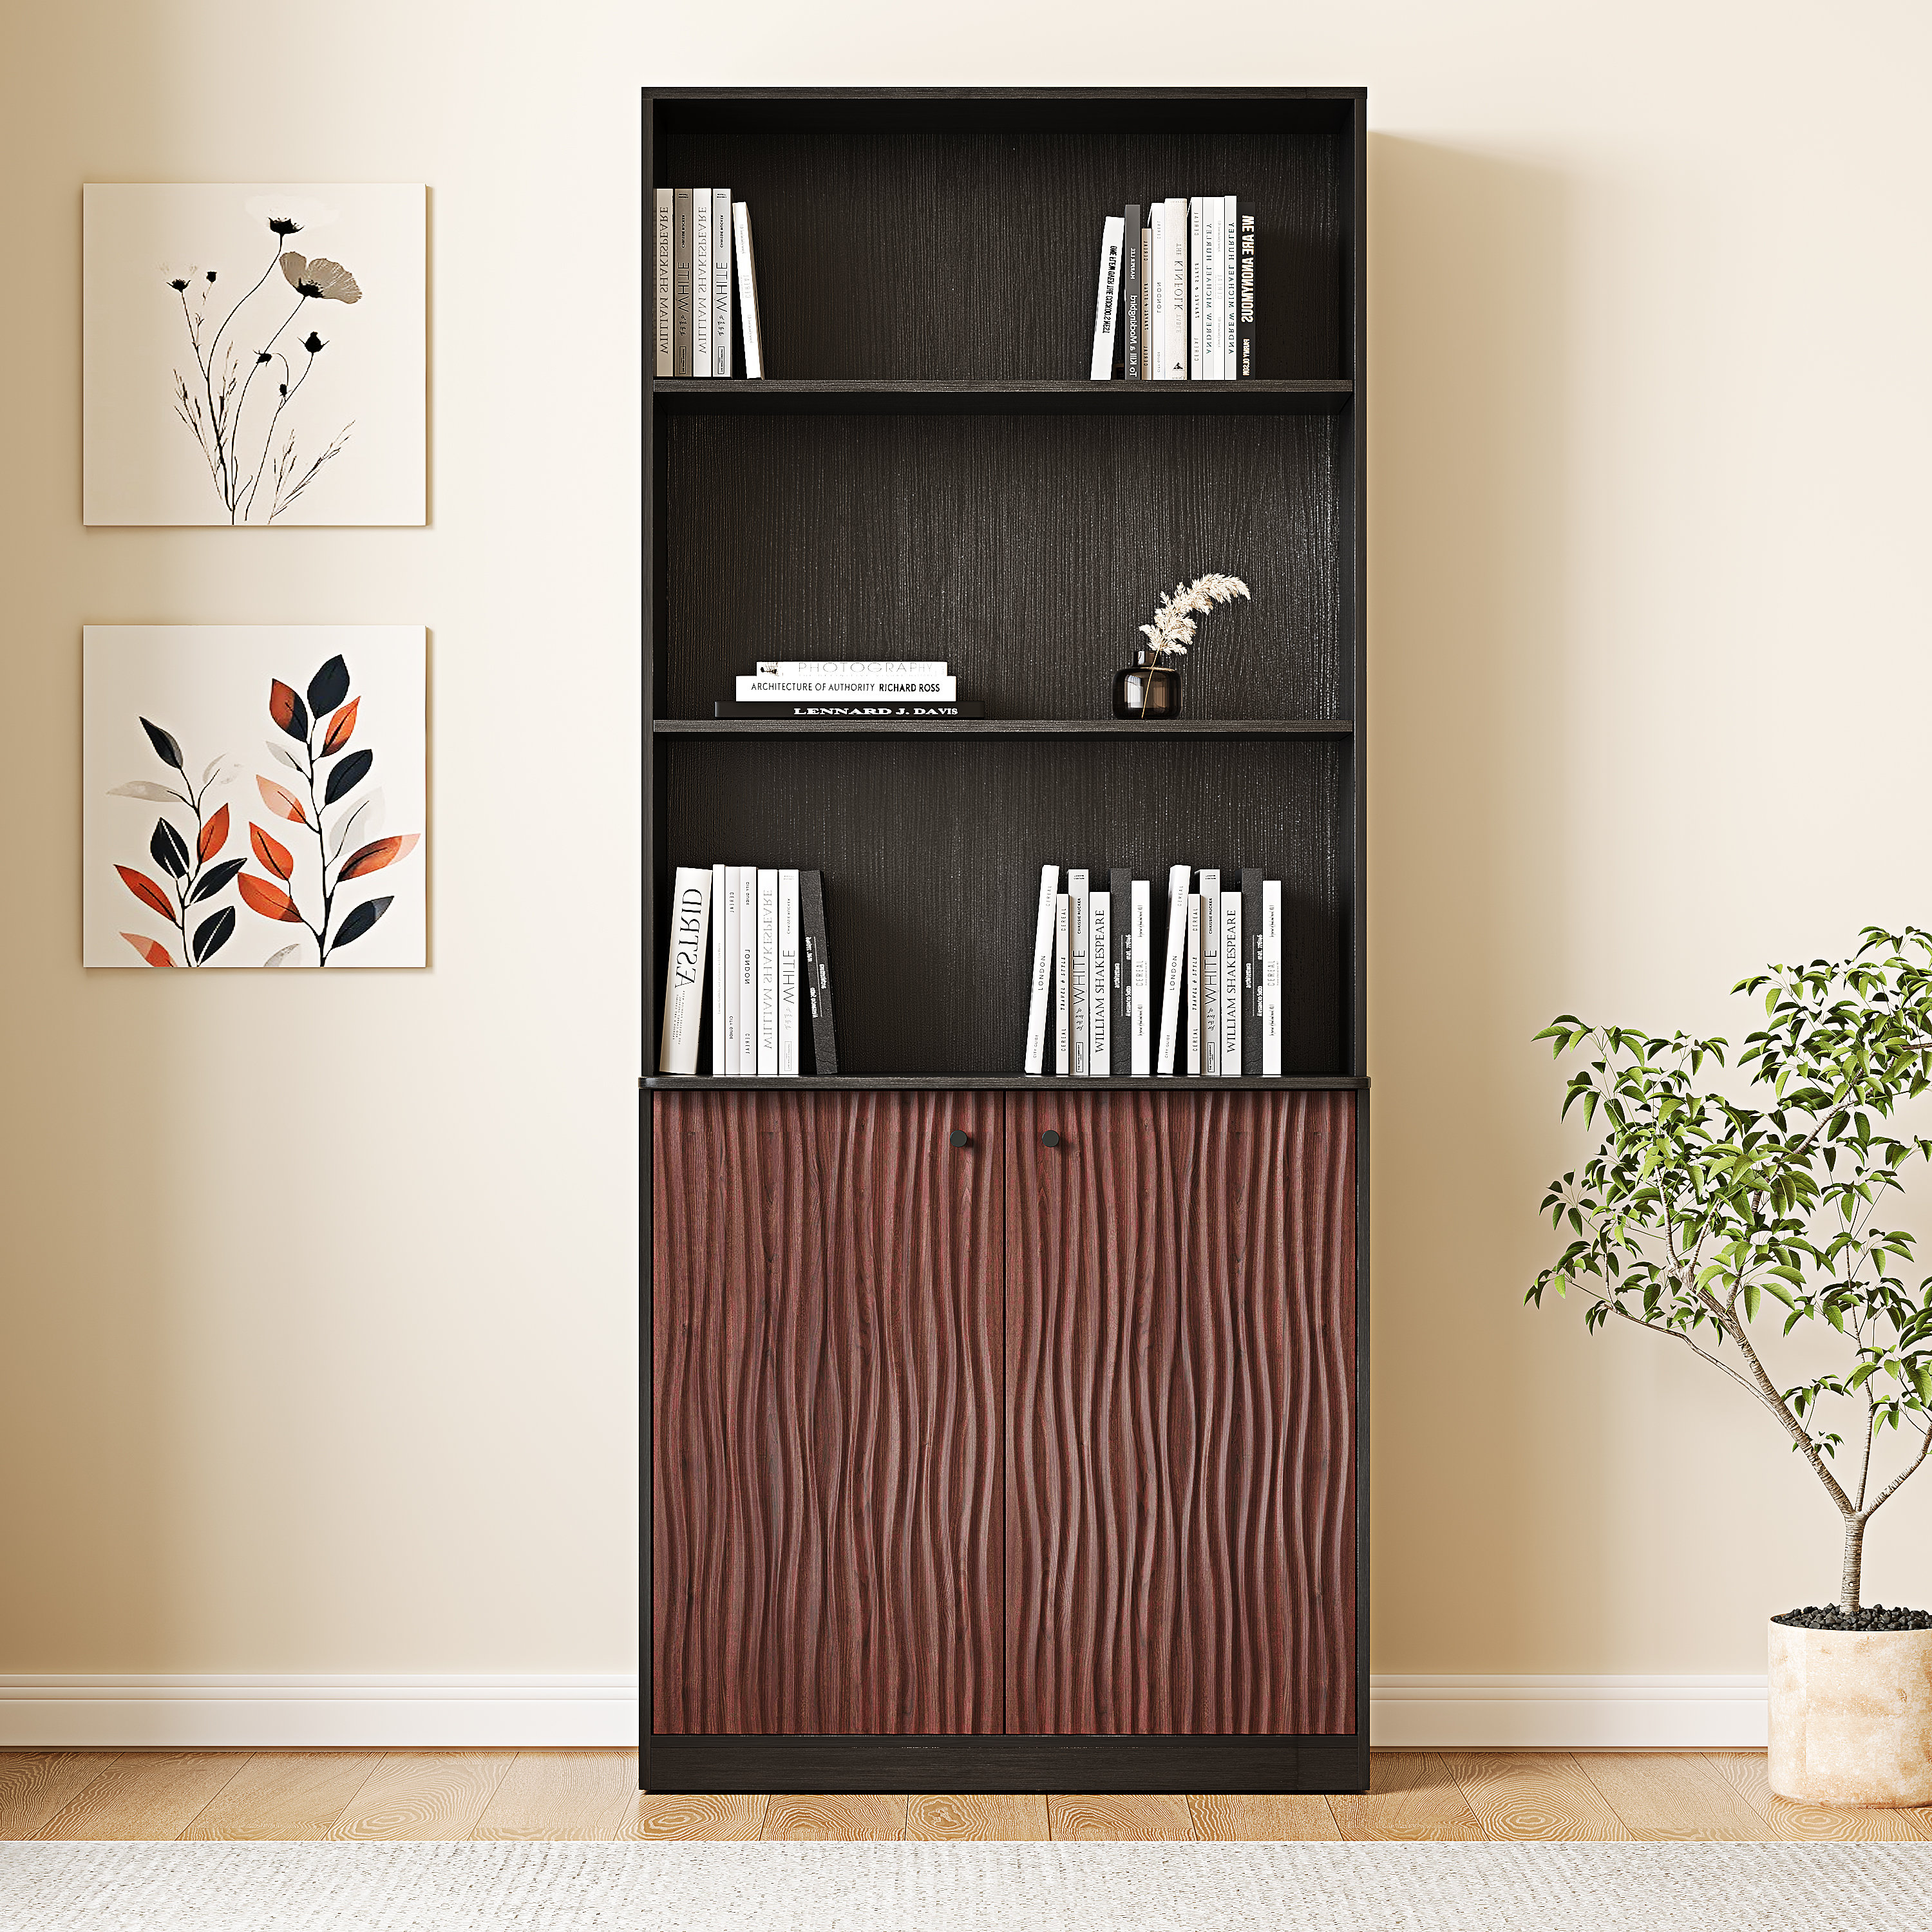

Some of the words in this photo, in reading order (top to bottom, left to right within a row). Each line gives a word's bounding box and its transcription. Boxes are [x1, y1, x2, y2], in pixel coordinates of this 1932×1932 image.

[798, 662, 933, 672] PHOTOGRAPHY
[751, 682, 813, 691] ARCHITECTURE
[815, 683, 826, 691] OF
[828, 683, 875, 692] AUTHORITY
[879, 683, 916, 692] RICHARD
[919, 683, 940, 692] ROSS
[1095, 910, 1104, 994] SHAKESPEARE
[1226, 910, 1236, 994] SHAKESPEARE
[1037, 956, 1046, 990] LONDON
[1072, 949, 1086, 1005] WHITE
[1135, 960, 1144, 987] CEREAL
[1169, 956, 1177, 990] LONDON
[1204, 949, 1217, 1005] WHITE
[1267, 960, 1275, 987] CEREAL
[1095, 997, 1104, 1054] WILLIAM
[1226, 998, 1236, 1053] WILLIAM
